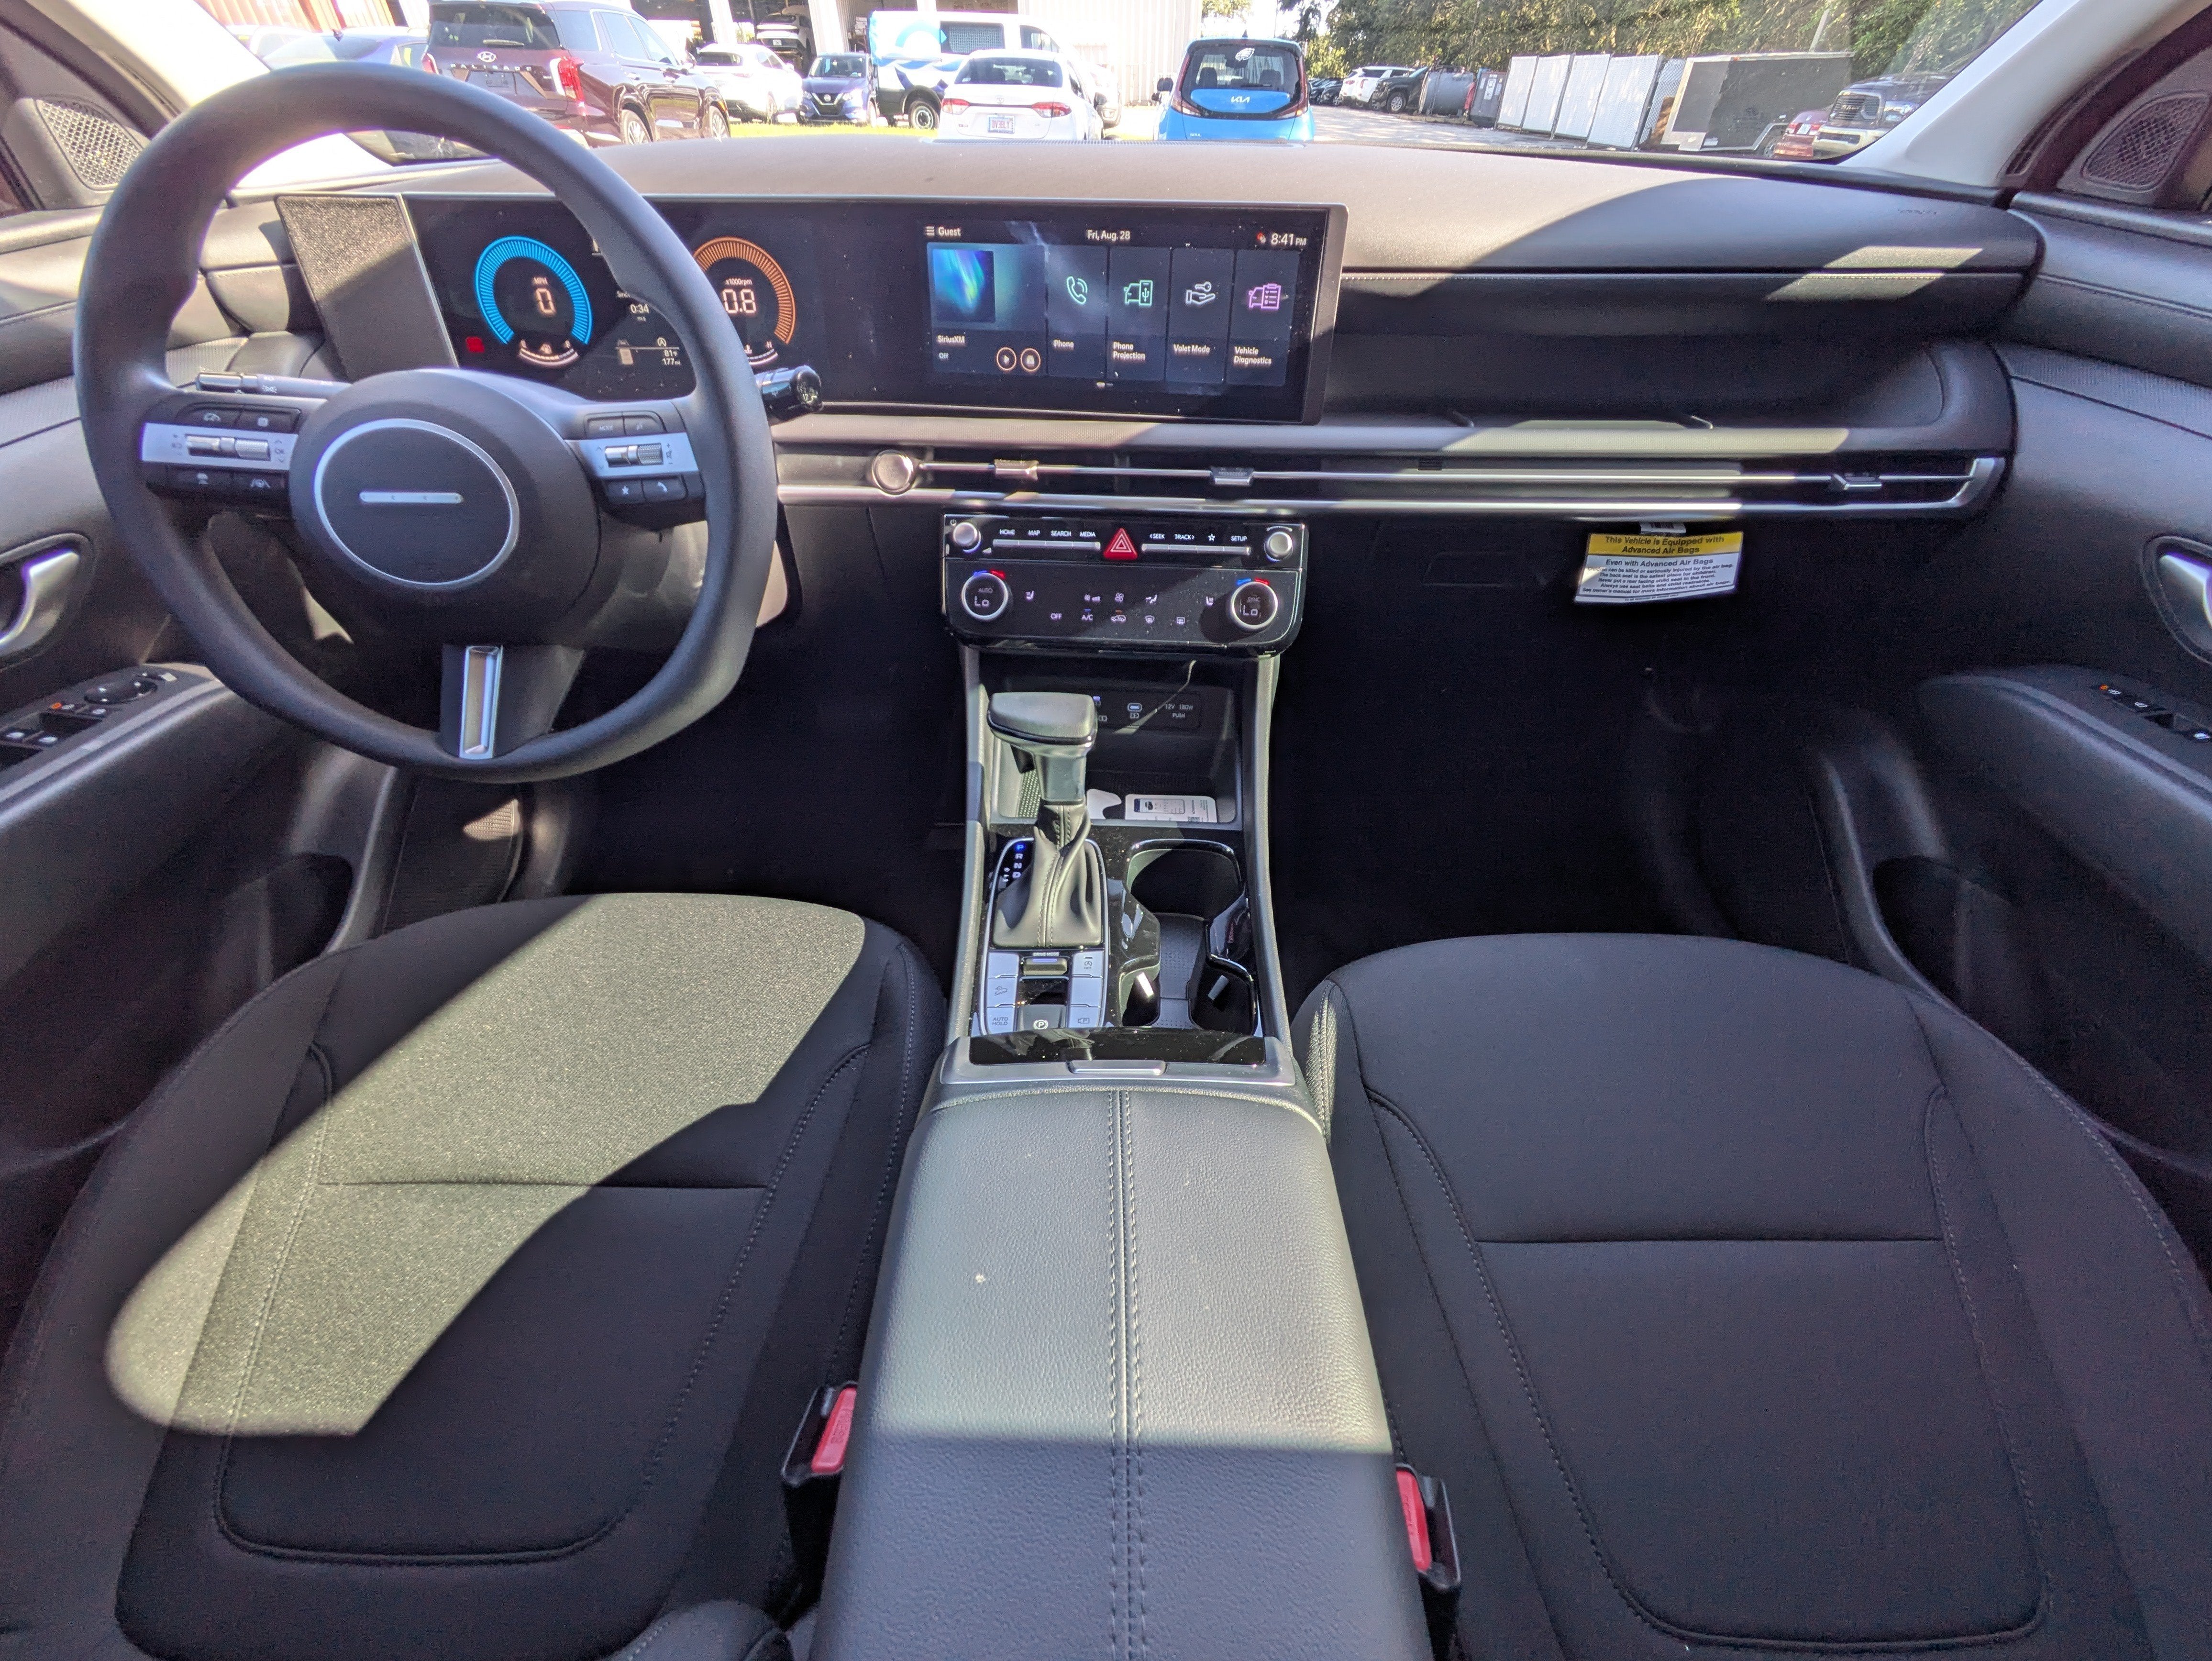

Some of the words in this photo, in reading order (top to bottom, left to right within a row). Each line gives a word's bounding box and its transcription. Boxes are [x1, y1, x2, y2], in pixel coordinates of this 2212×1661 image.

[938, 227, 961, 236] Guest
[1087, 230, 1099, 241] Fri,
[1101, 231, 1118, 241] Aug.
[1120, 231, 1130, 240] 28
[1271, 233, 1294, 245] 8:41
[536, 288, 555, 315] 0
[722, 289, 756, 314] 0.8
[630, 304, 649, 313] 0:34
[938, 335, 965, 343] SiriusXM
[1054, 339, 1074, 347] Phone
[1113, 342, 1134, 350] Phone
[1173, 344, 1191, 353] Valet
[1235, 346, 1259, 354] Vehicle
[1113, 351, 1146, 360] Projection
[1234, 356, 1272, 365] Diagnostics
[1662, 537, 1703, 546] Equipped
